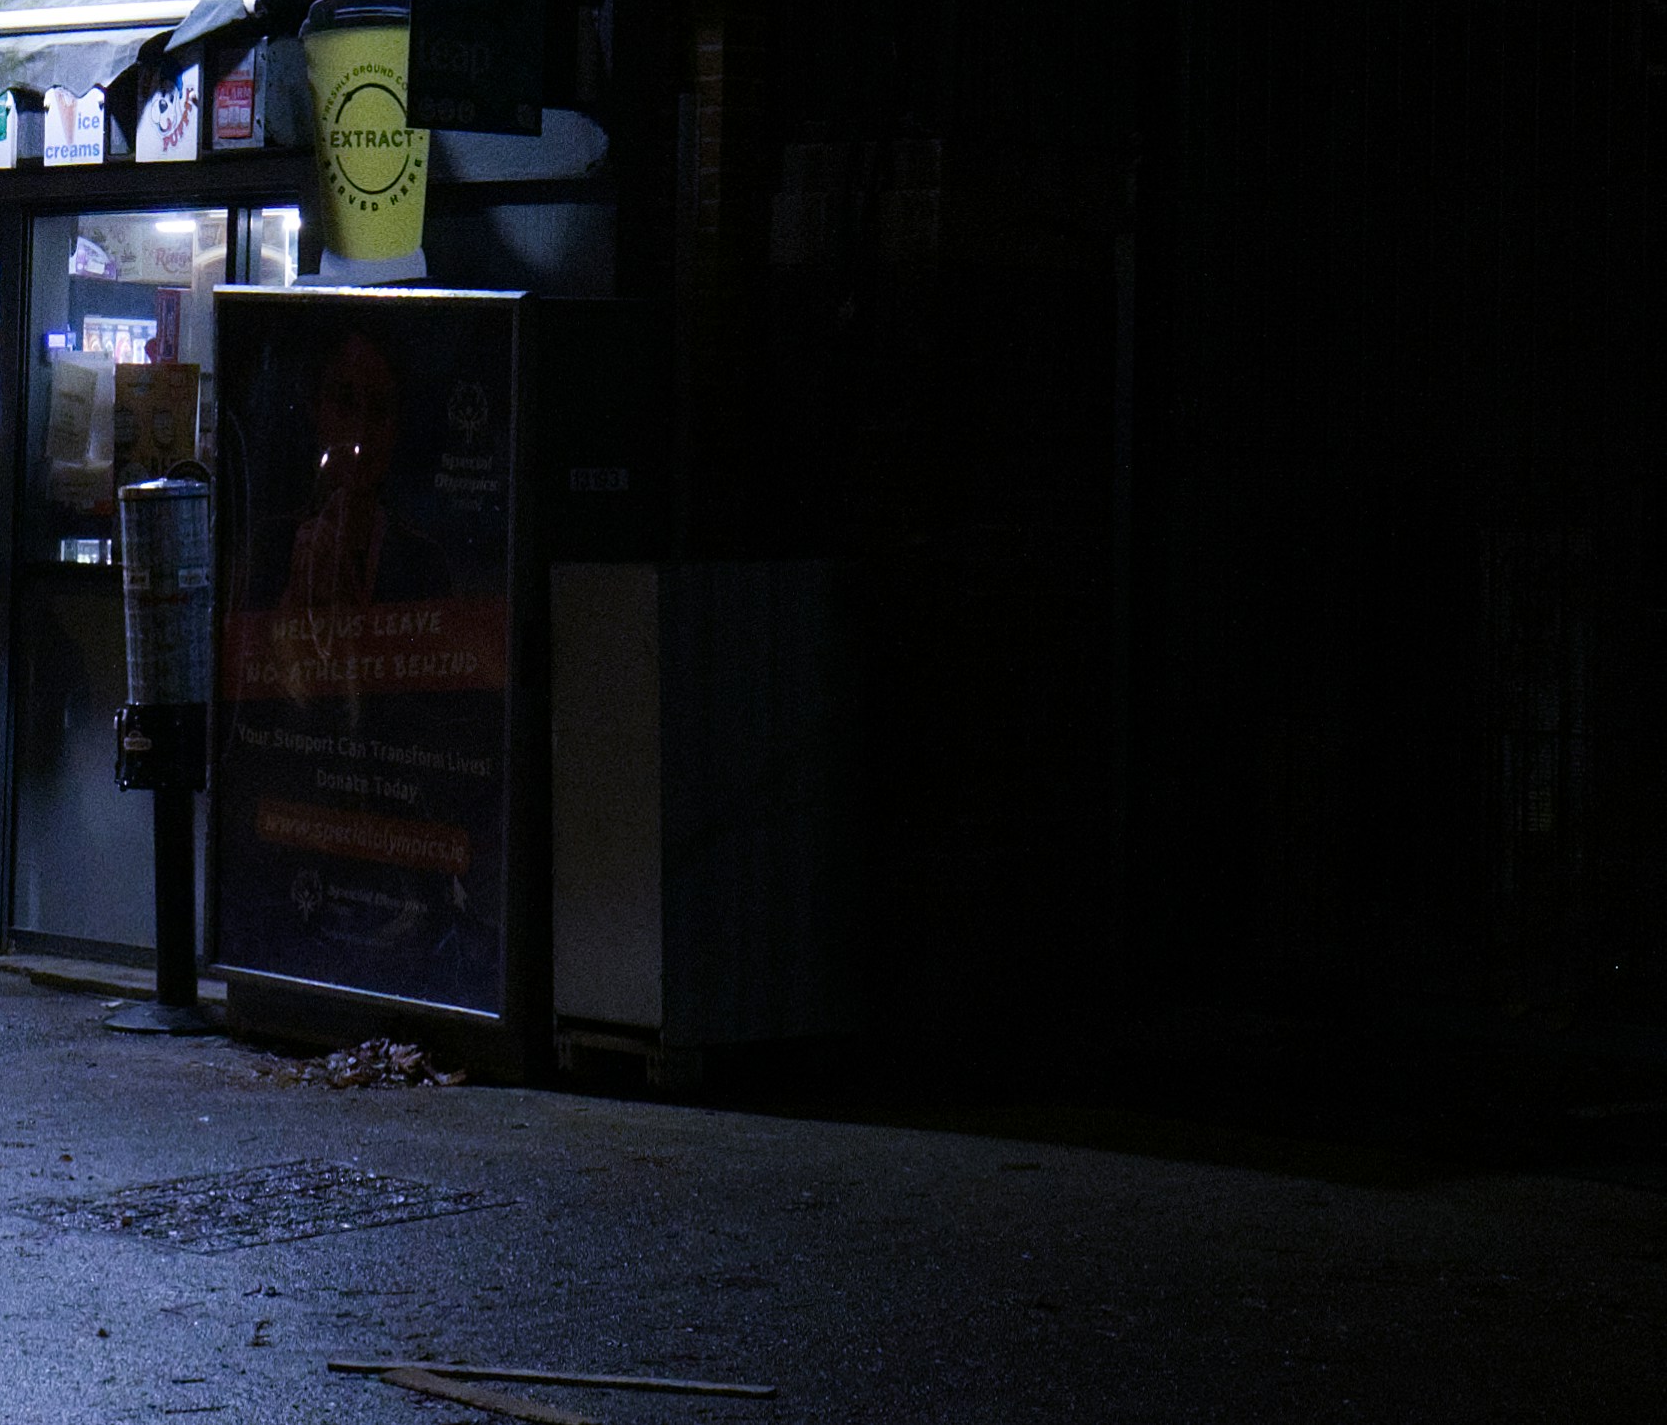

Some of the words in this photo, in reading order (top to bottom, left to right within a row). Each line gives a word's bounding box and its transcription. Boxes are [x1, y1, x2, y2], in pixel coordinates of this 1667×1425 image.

[352, 62, 395, 78] GROUND
[77, 112, 101, 131] ice
[45, 141, 101, 160] creams
[330, 129, 415, 149] EXTRACT
[323, 158, 379, 212] SERVED
[389, 157, 424, 207] HERE
[372, 610, 443, 639] LEAVE
[393, 650, 479, 677] BEHIND
[238, 726, 269, 747] Your
[272, 728, 334, 756] Support
[337, 736, 367, 758] Can
[369, 739, 445, 769] Transform
[315, 767, 369, 794] Donate
[372, 773, 419, 804] Today
